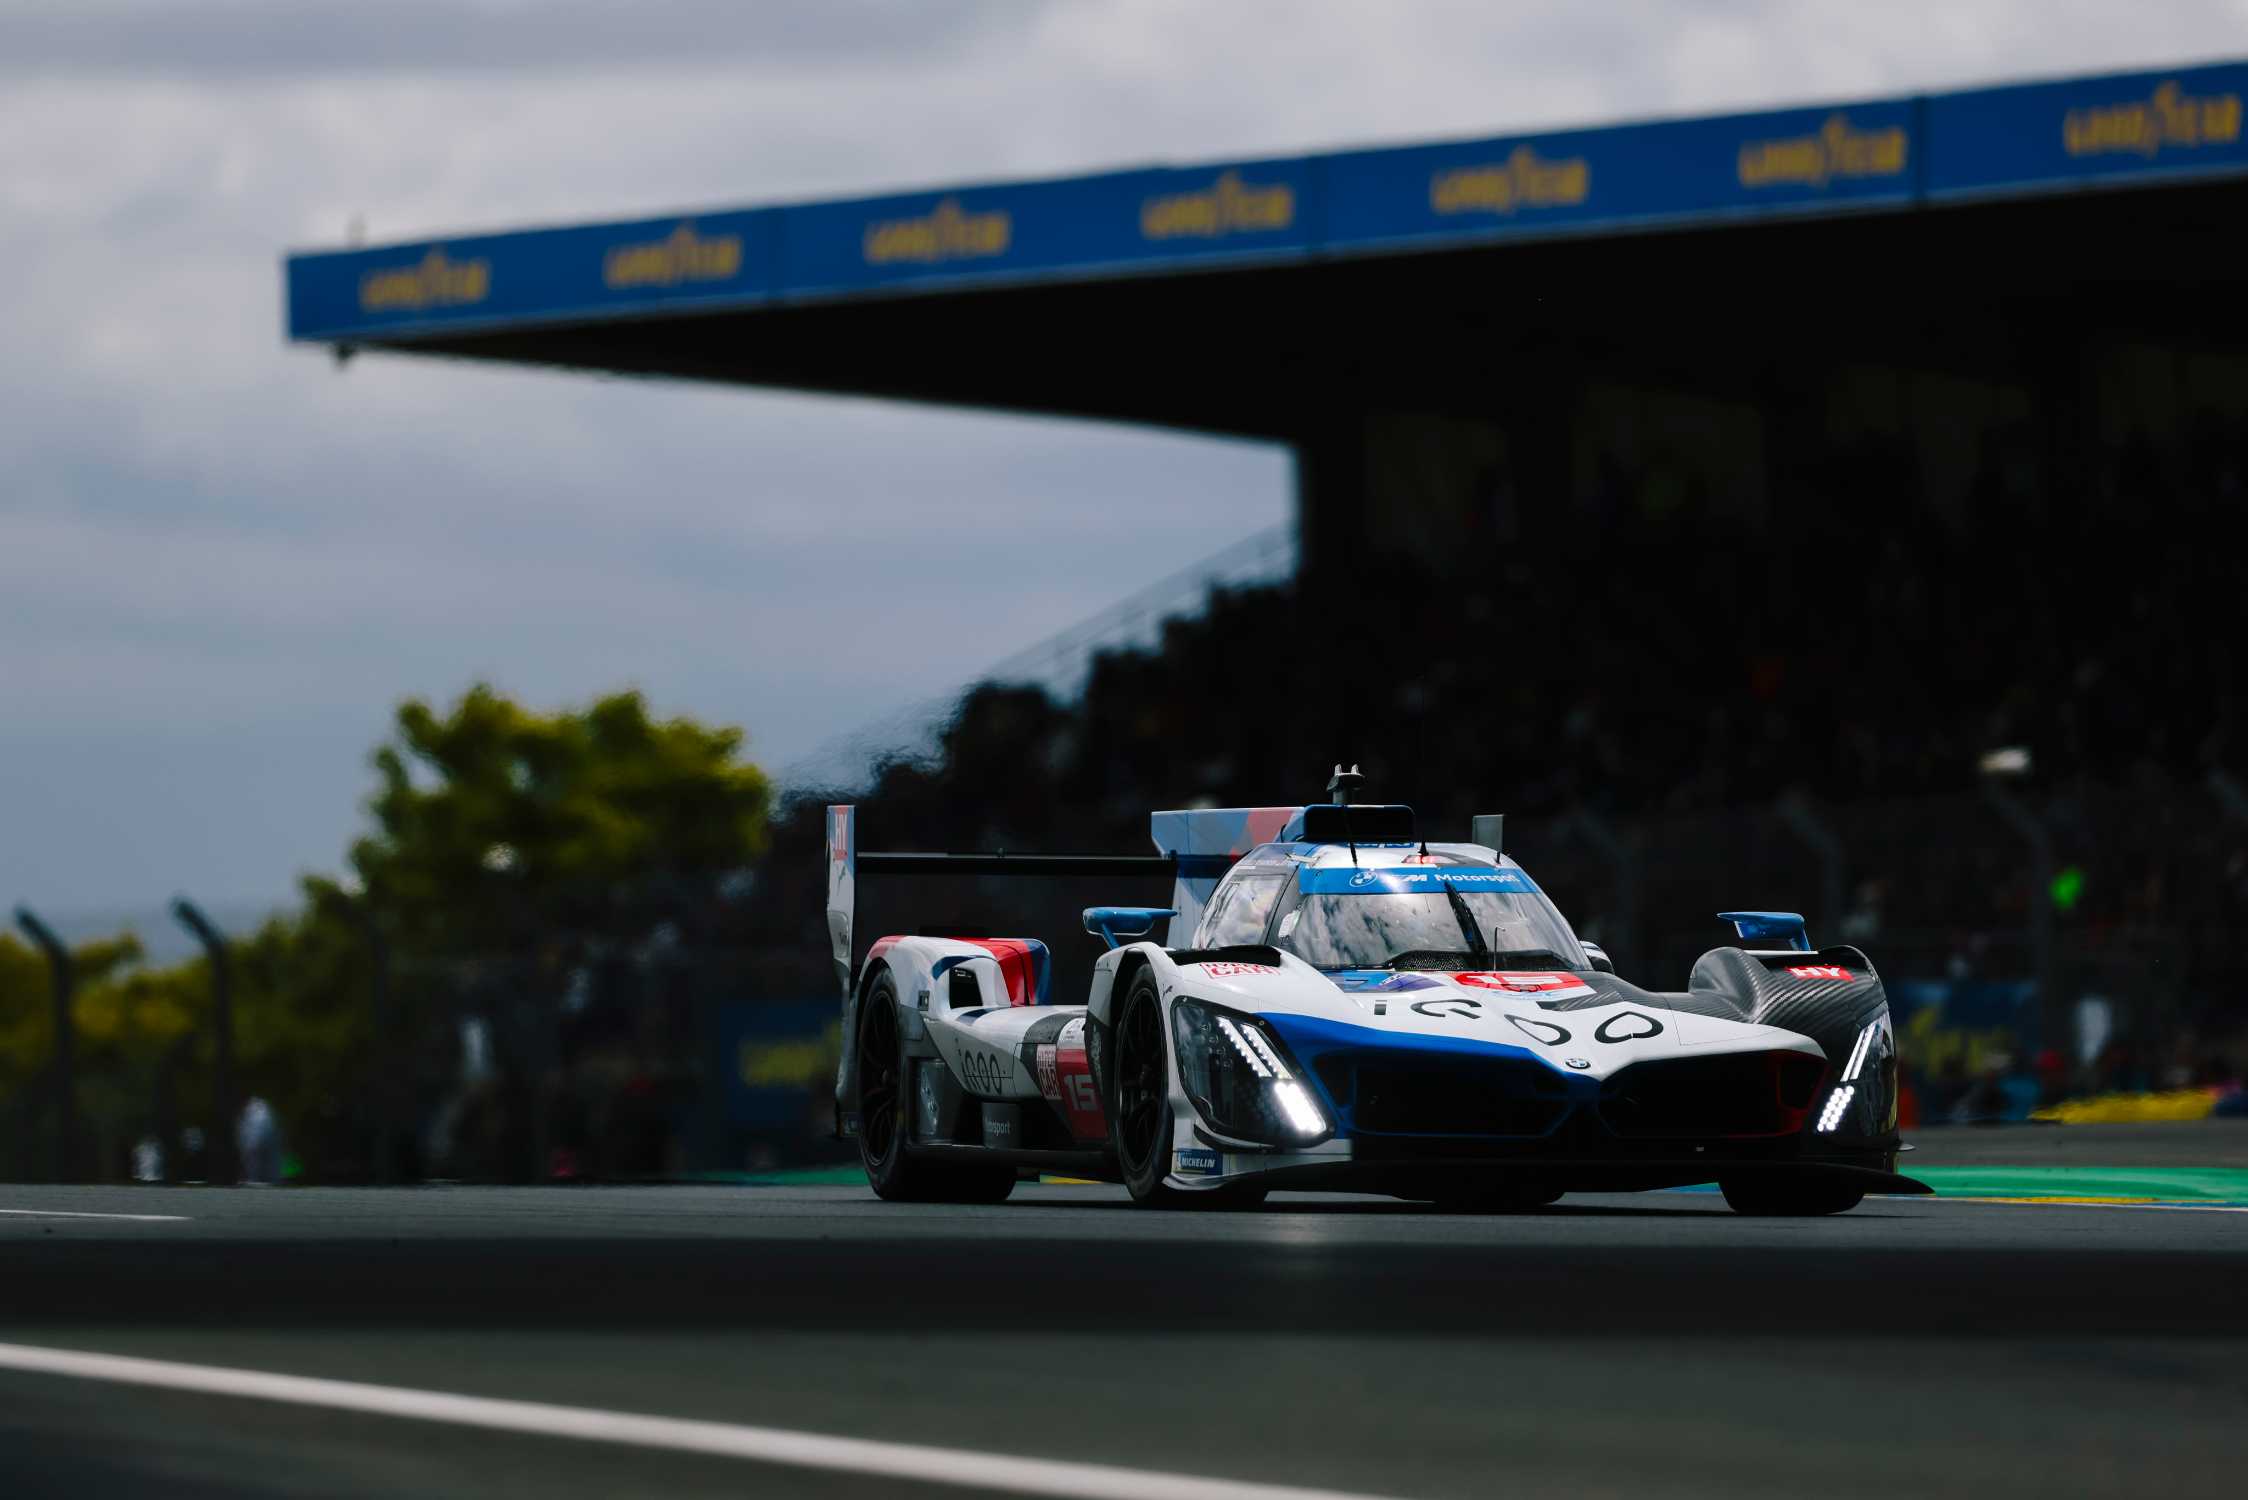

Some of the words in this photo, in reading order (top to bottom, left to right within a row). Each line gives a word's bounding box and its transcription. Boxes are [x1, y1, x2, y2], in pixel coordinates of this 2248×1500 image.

[1434, 873, 1520, 884] Motorsport
[1789, 967, 1841, 977] HY
[1039, 1068, 1061, 1097] CAR
[1064, 1073, 1099, 1112] 15
[1181, 1156, 1216, 1169] MICHELIN
